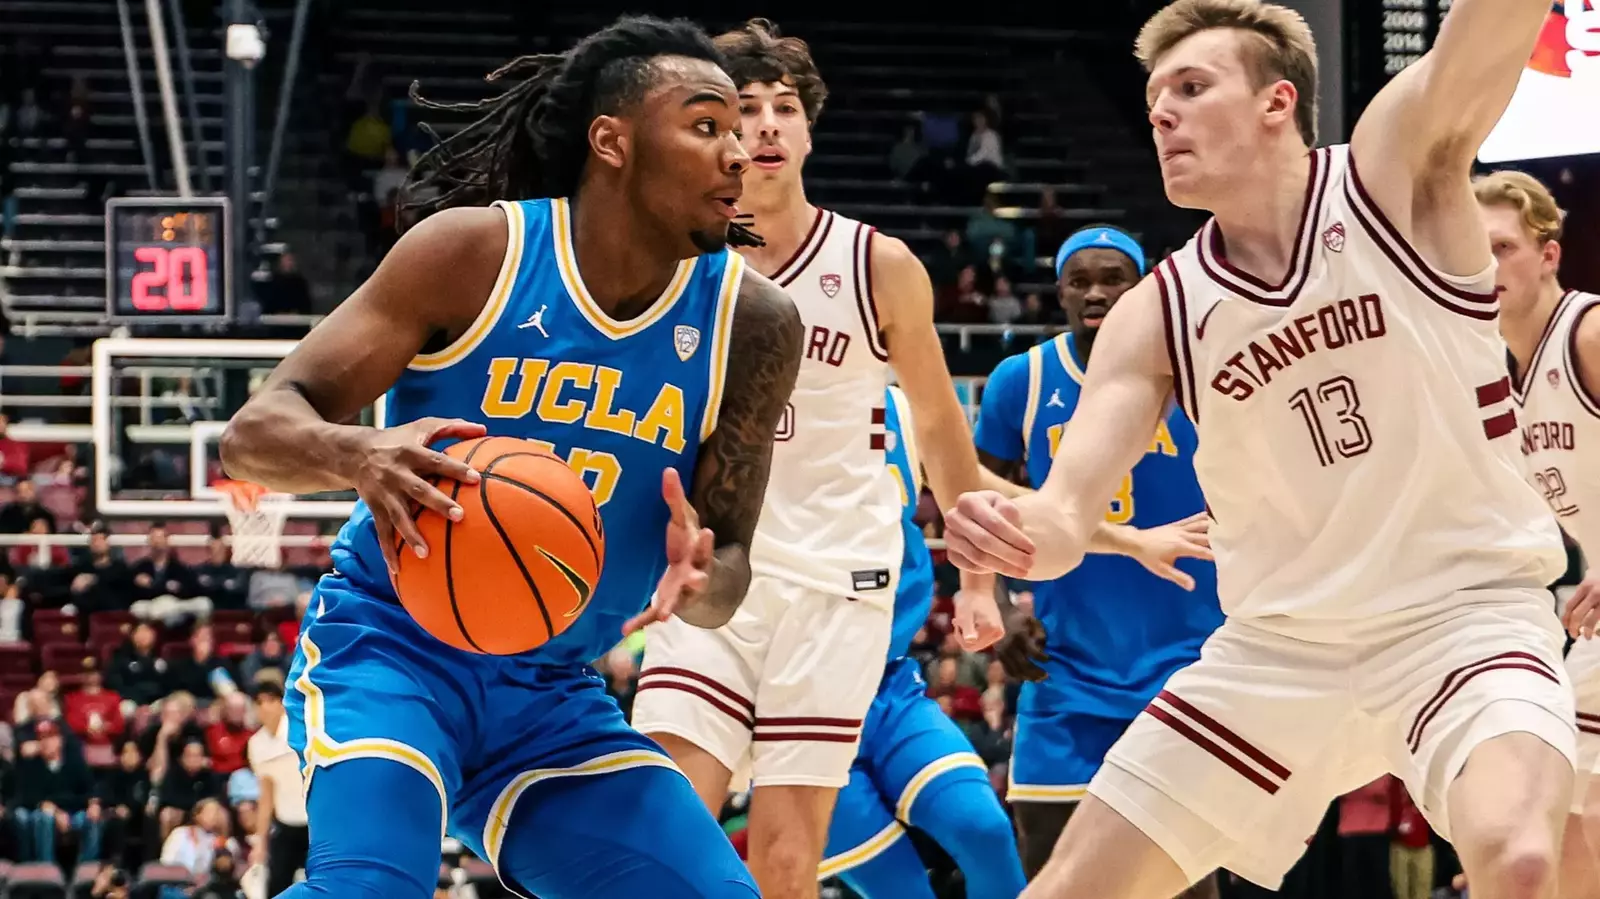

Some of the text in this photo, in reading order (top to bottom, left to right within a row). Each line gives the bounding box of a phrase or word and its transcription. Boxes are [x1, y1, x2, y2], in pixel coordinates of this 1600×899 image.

[1383, 10, 1425, 30] 2009
[131, 247, 209, 311] 20
[1211, 293, 1387, 402] STANFORD
[480, 356, 687, 455] UCLA
[1288, 375, 1373, 468] 13
